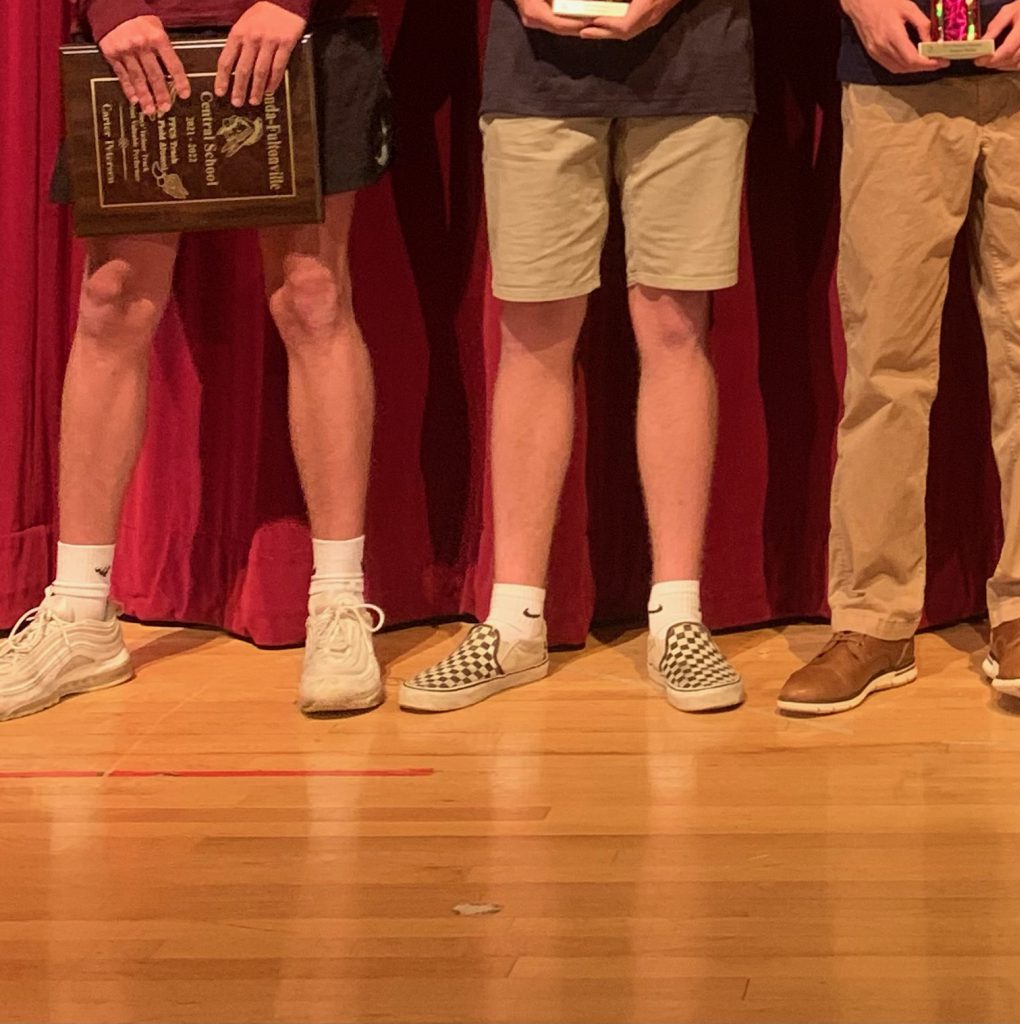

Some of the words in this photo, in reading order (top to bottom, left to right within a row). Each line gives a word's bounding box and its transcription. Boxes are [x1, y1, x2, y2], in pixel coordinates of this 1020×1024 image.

[102, 103, 112, 137] Carter
[200, 91, 217, 141] Central
[263, 90, 285, 191] onda-Fultonville
[204, 143, 219, 186] School
